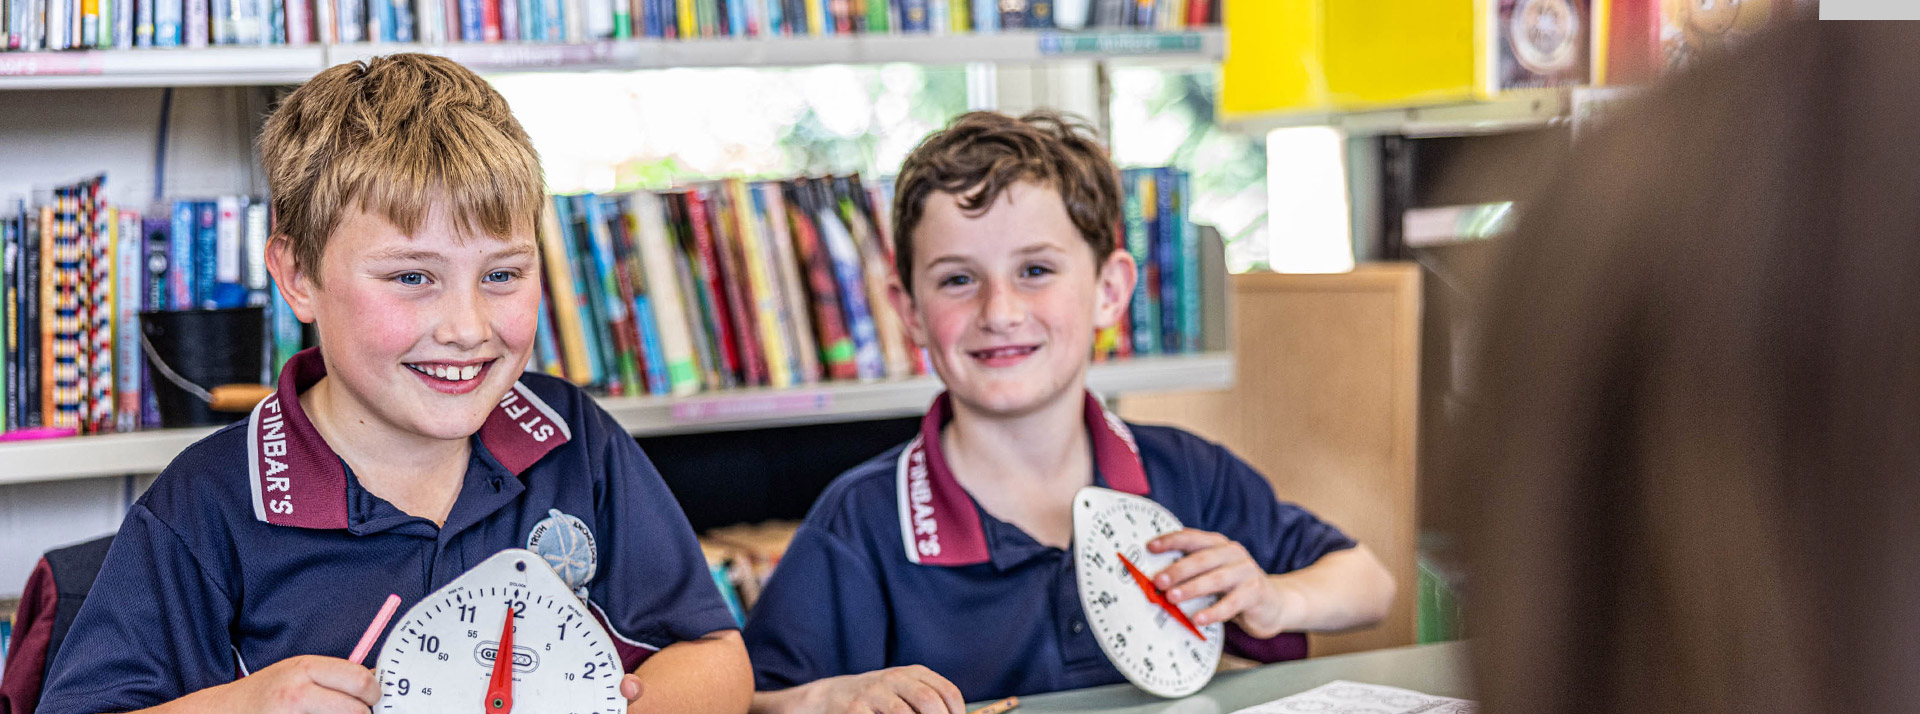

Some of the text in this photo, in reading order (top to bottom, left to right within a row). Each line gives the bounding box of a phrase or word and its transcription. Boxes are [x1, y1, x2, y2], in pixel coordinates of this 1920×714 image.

[519, 416, 554, 442] ST
[263, 398, 293, 515] FINBAR'S
[530, 524, 547, 546] TRUTH
[458, 604, 476, 623] 11
[504, 599, 526, 619] 12
[467, 629, 478, 639] 55
[557, 622, 566, 641] 1
[417, 633, 440, 654] 10
[545, 643, 551, 651] 5
[438, 652, 449, 662] 50
[564, 672, 575, 681] 10
[582, 662, 596, 680] 2
[398, 678, 410, 696] 9
[421, 687, 432, 696] 45
